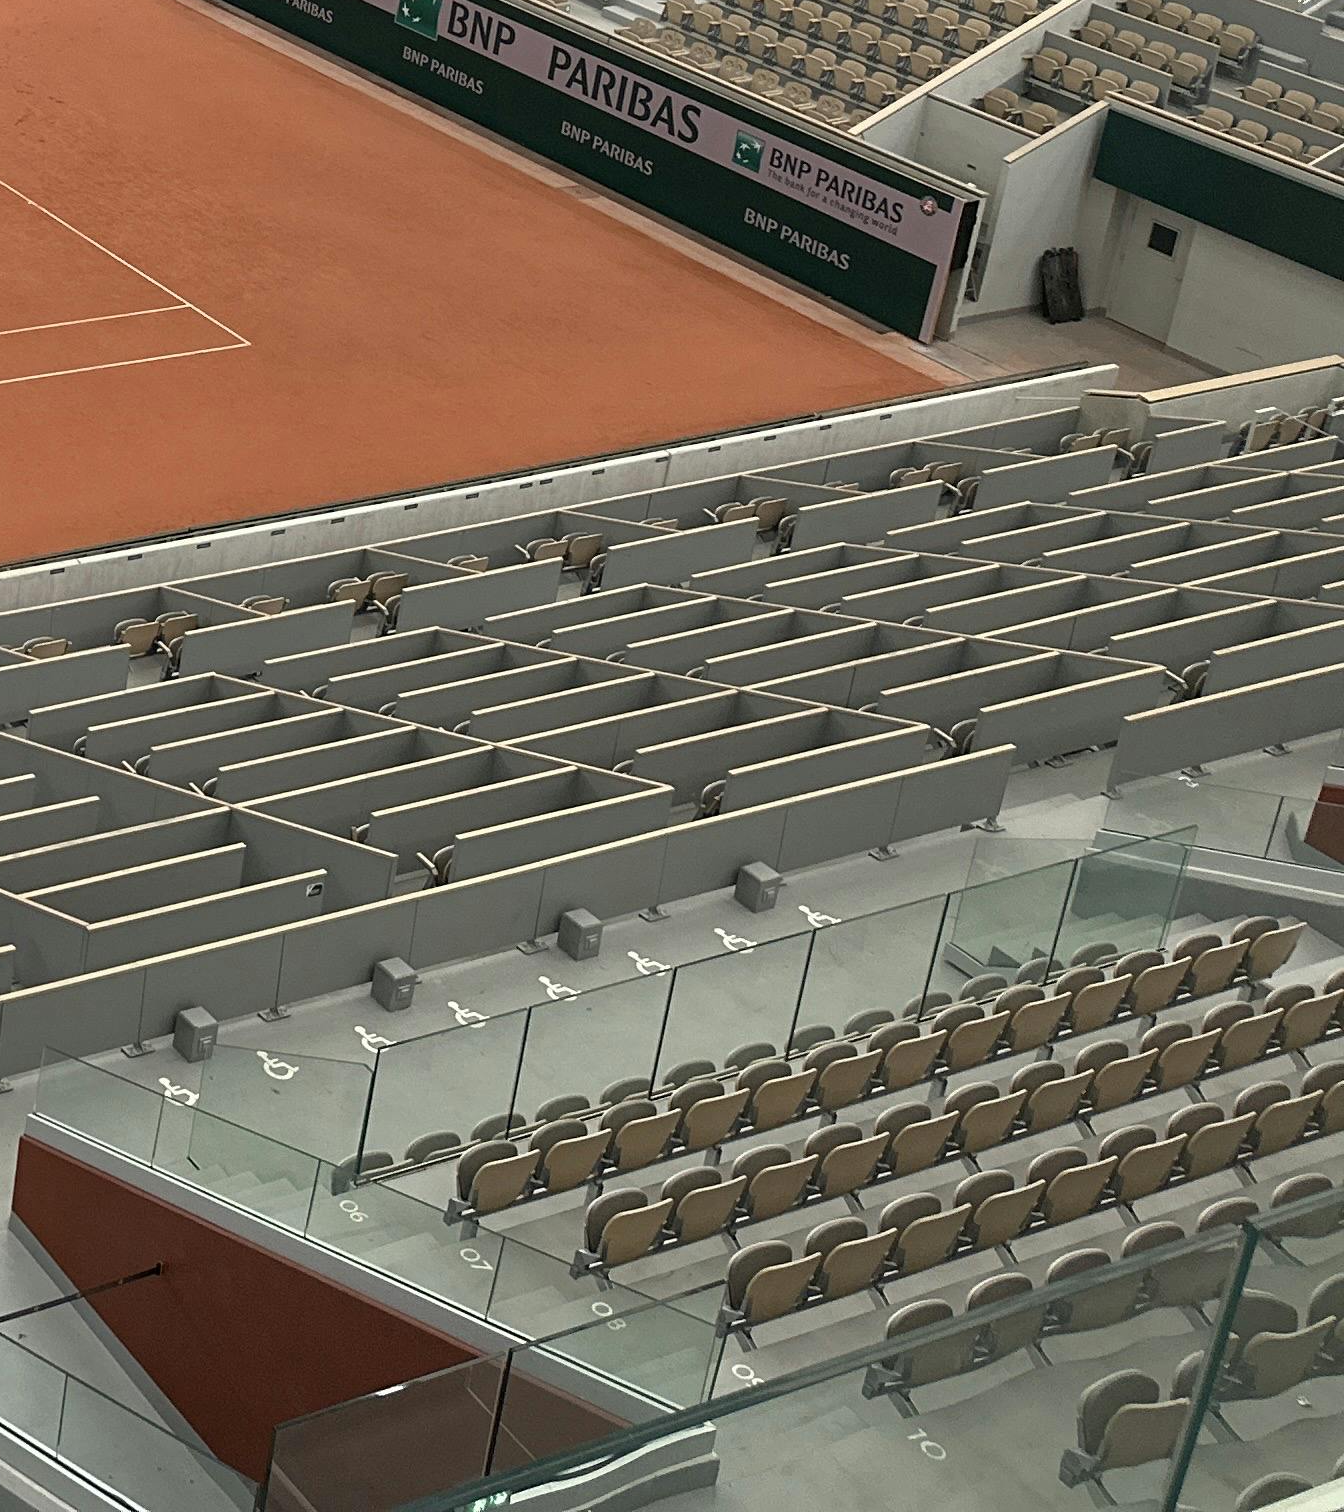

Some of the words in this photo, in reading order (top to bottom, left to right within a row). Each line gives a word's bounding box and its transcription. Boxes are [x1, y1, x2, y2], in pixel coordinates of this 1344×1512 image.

[402, 45, 430, 67] BNP
[430, 57, 484, 95] PARIBAS
[447, 0, 516, 56] BNP
[547, 44, 702, 144] PARIBAS
[561, 120, 591, 145] BNP
[592, 135, 655, 177] PARIBAS
[766, 168, 782, 183] The
[784, 176, 804, 192] bank
[806, 185, 820, 201] for
[828, 197, 869, 224] changing
[871, 217, 898, 236] world
[769, 147, 812, 180] BNP
[815, 167, 904, 224] PARIBAS
[744, 207, 778, 234] BNP
[779, 224, 851, 271] PARIBAS
[339, 1199, 369, 1223] 06
[460, 1247, 494, 1273] 07
[591, 1301, 627, 1331] 08
[907, 1427, 947, 1461] 10
